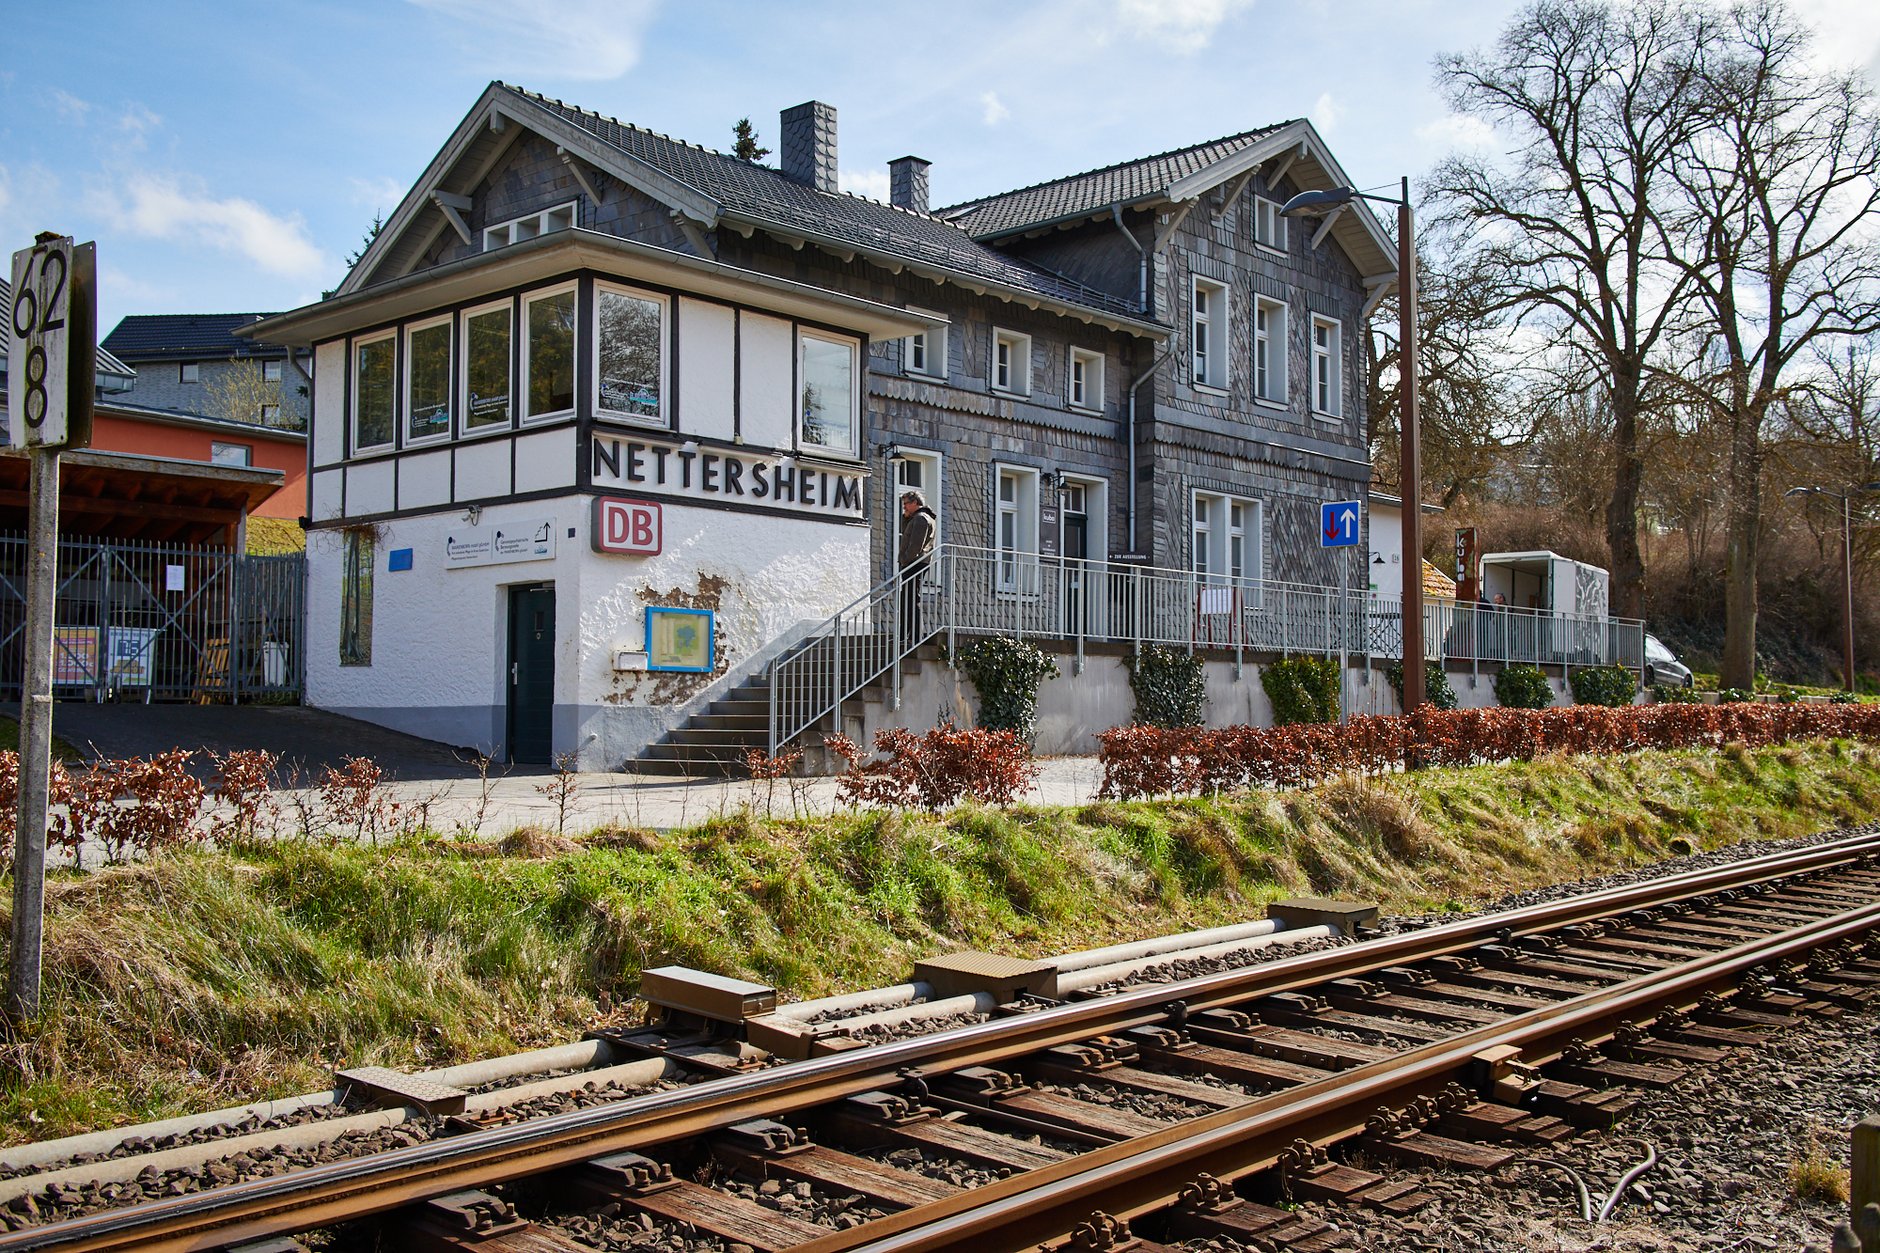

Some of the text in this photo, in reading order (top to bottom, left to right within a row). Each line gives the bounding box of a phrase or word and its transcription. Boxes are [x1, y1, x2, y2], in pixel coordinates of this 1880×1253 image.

[13, 249, 67, 339] 62
[24, 345, 48, 428] 8
[593, 438, 862, 511] NETTERSHEIM
[608, 506, 653, 546] DB
